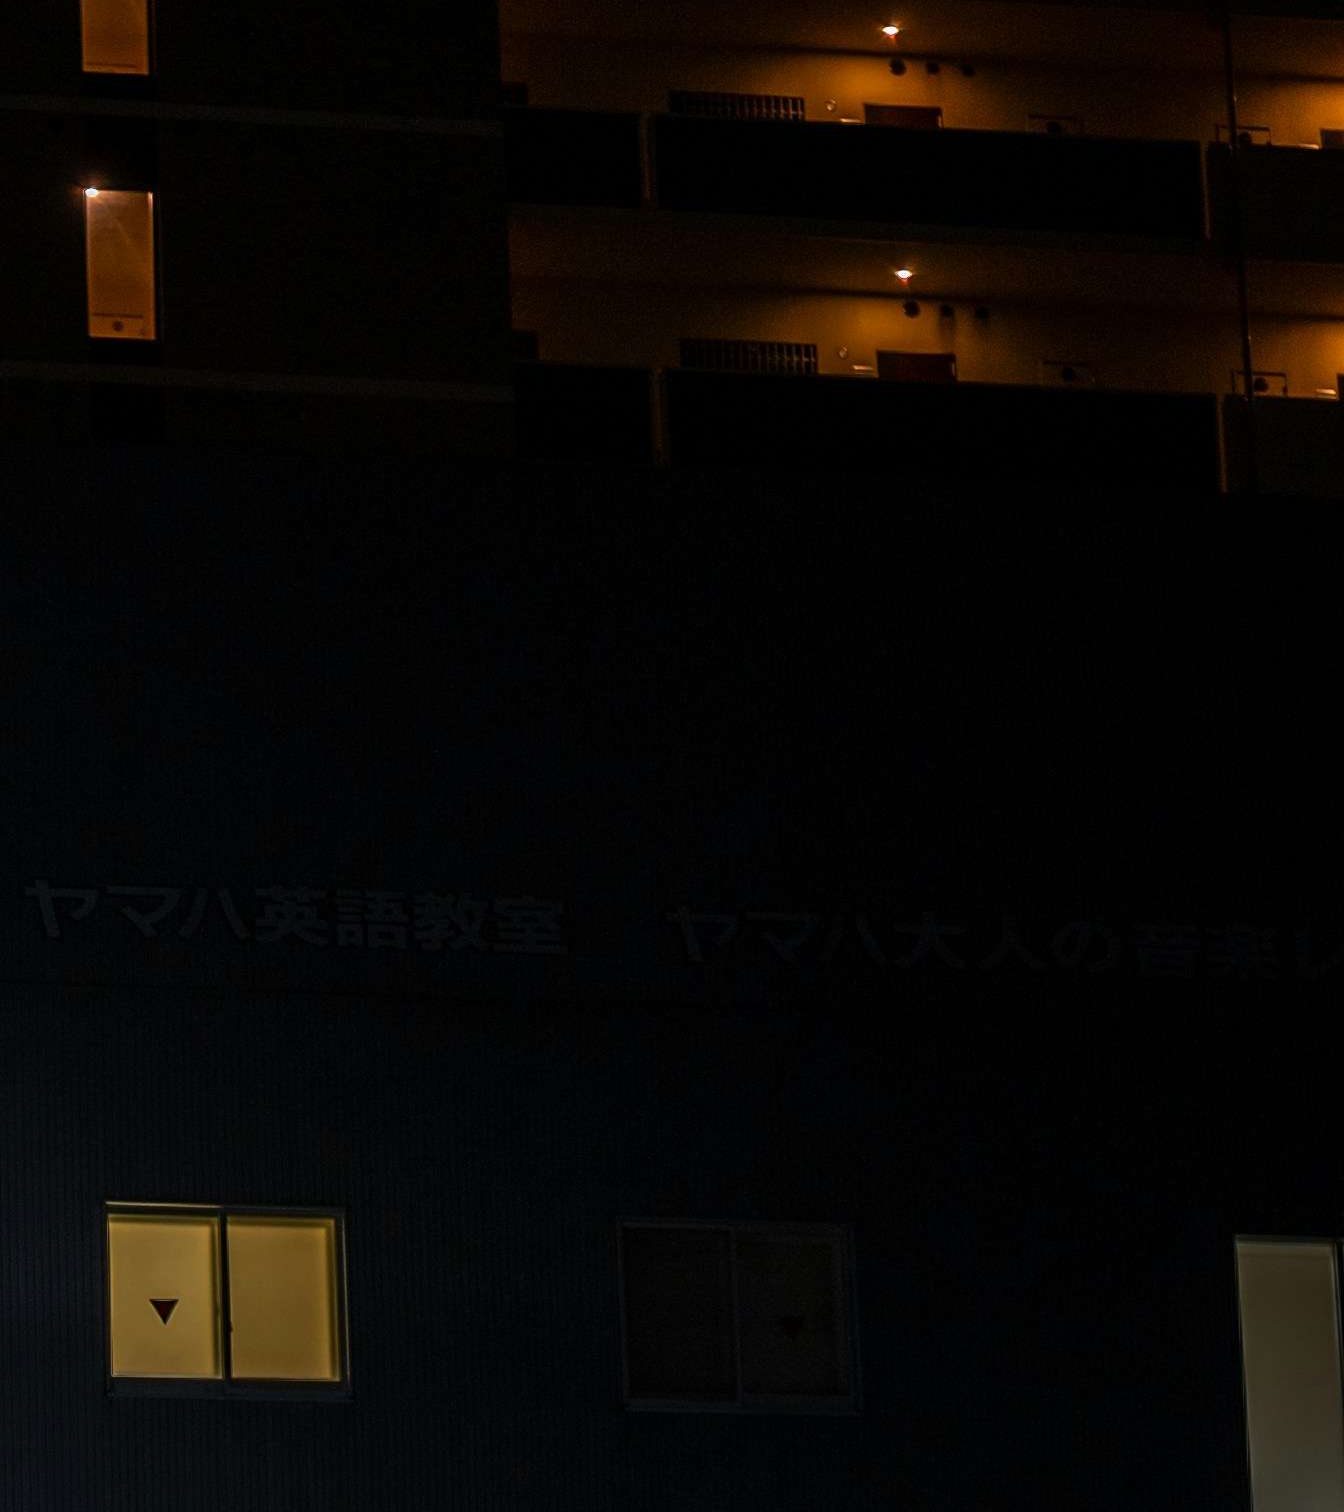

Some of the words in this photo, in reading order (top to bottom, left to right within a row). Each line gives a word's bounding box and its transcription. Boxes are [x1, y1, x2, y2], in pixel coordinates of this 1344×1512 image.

[24, 879, 568, 954] ヤマハ英語教室
